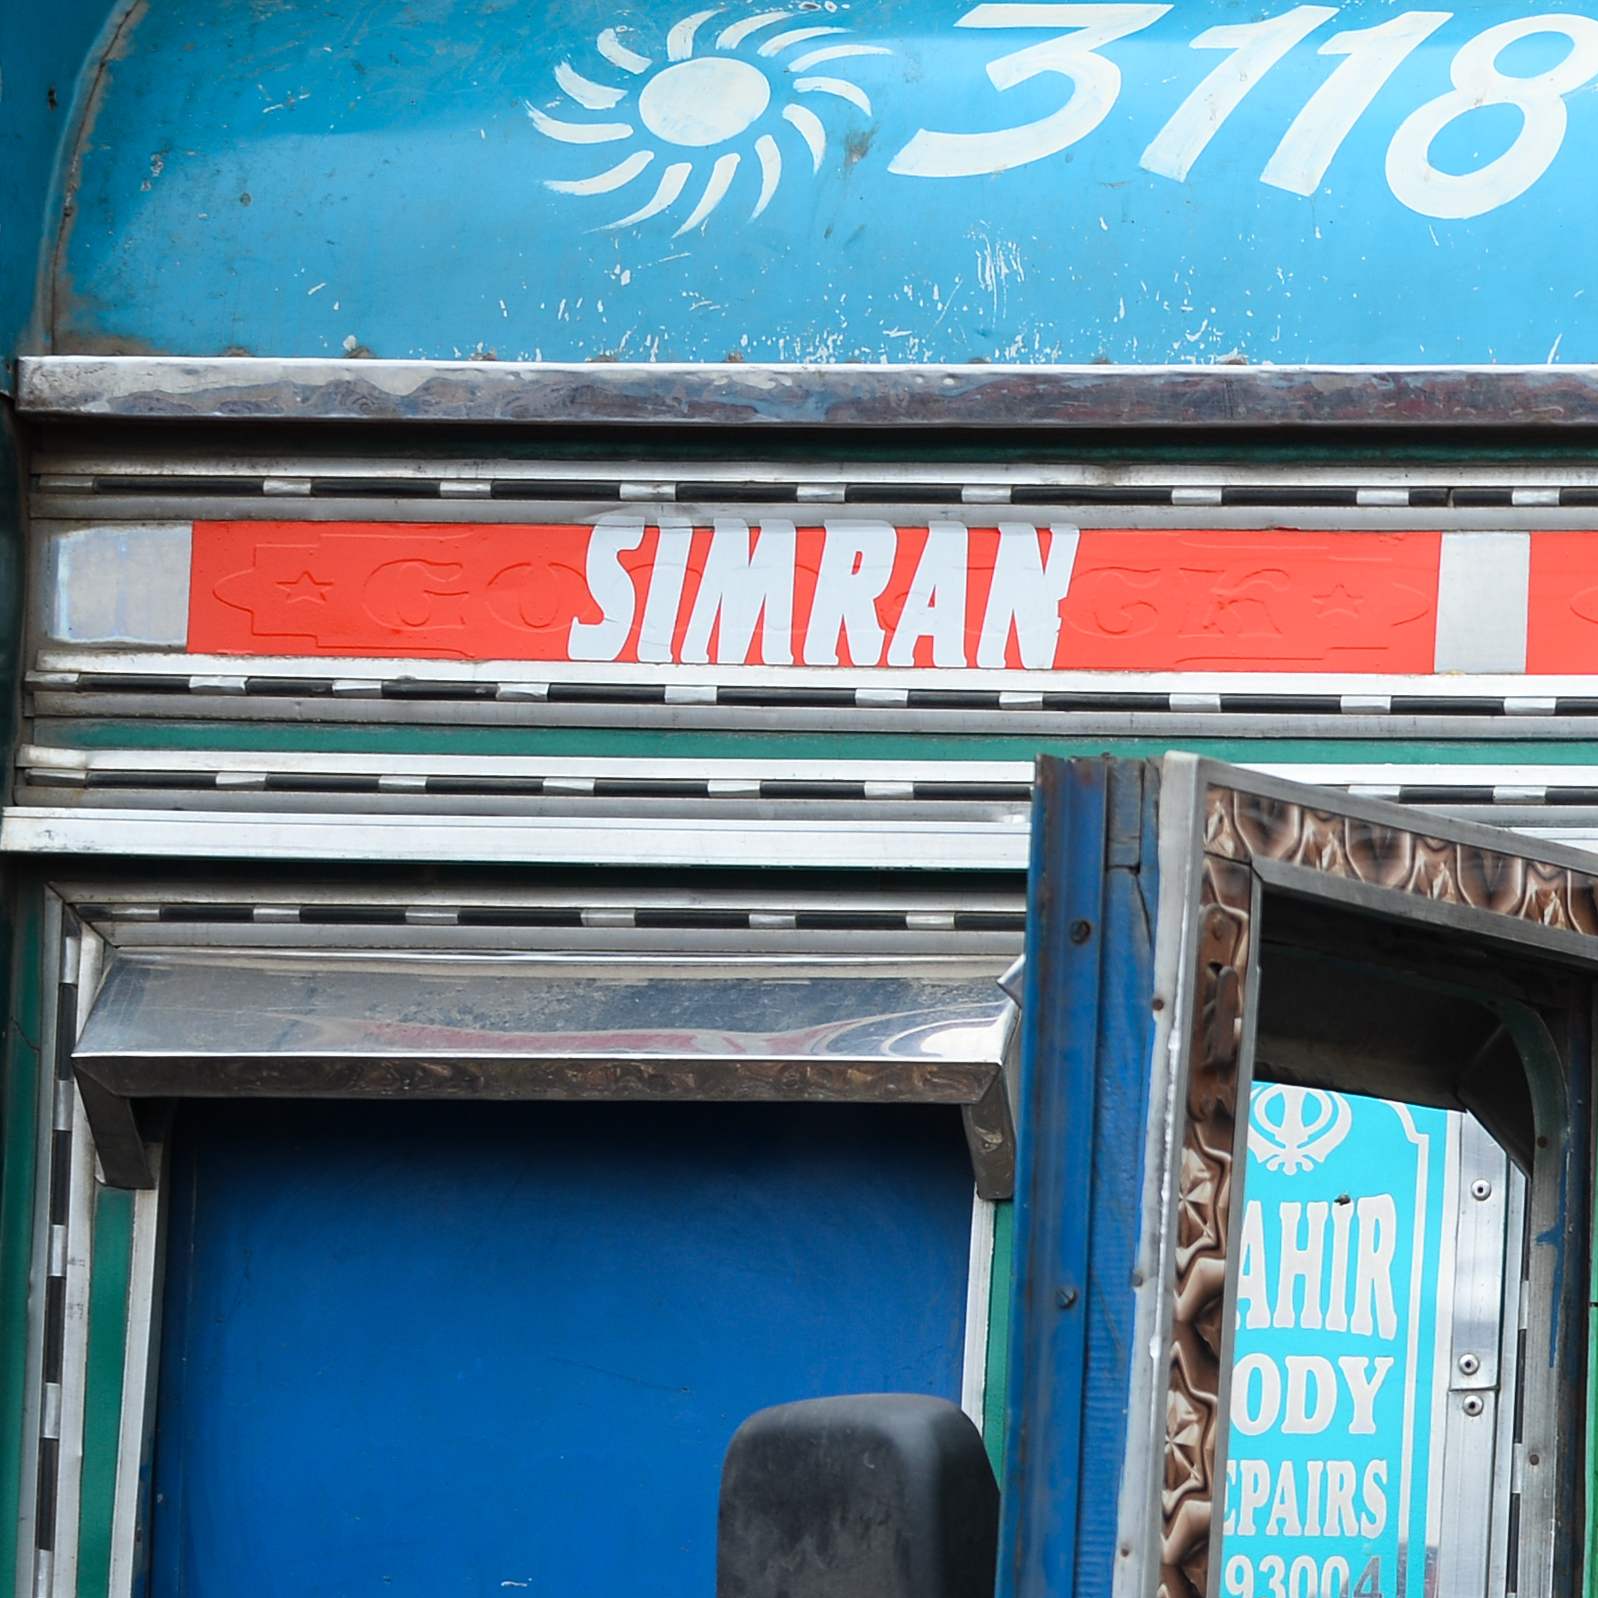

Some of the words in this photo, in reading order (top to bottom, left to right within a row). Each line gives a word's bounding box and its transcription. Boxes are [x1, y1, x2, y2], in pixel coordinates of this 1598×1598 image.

[568, 517, 1079, 669] SIMRAN
[1235, 1194, 1397, 1340] AHIR
[1230, 1353, 1394, 1436] ODY
[1223, 1459, 1388, 1540] EPAIRS
